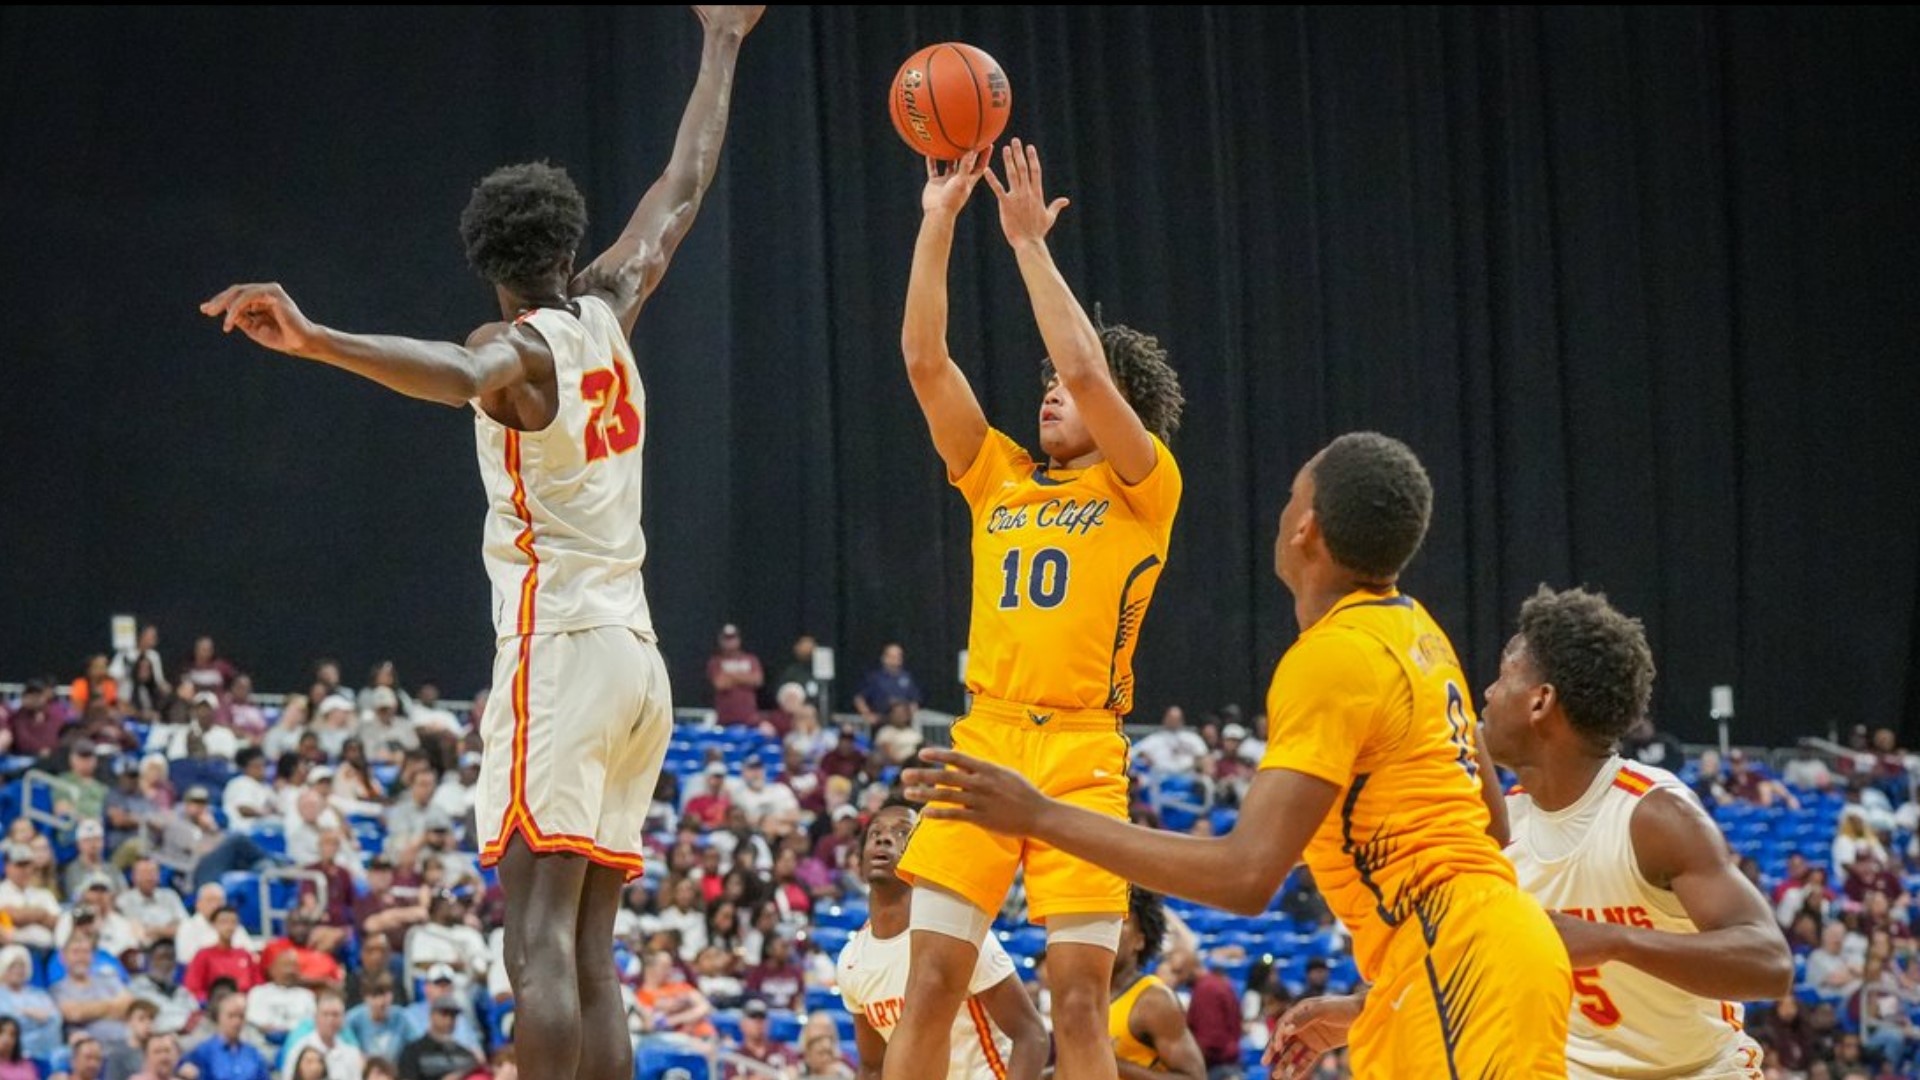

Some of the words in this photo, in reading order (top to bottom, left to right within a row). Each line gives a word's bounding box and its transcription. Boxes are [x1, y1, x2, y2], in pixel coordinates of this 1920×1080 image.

[580, 359, 641, 463] 23
[986, 505, 1029, 534] Oak
[1036, 499, 1110, 535] Cliff
[998, 546, 1071, 611] 10
[1573, 966, 1623, 1031] 5
